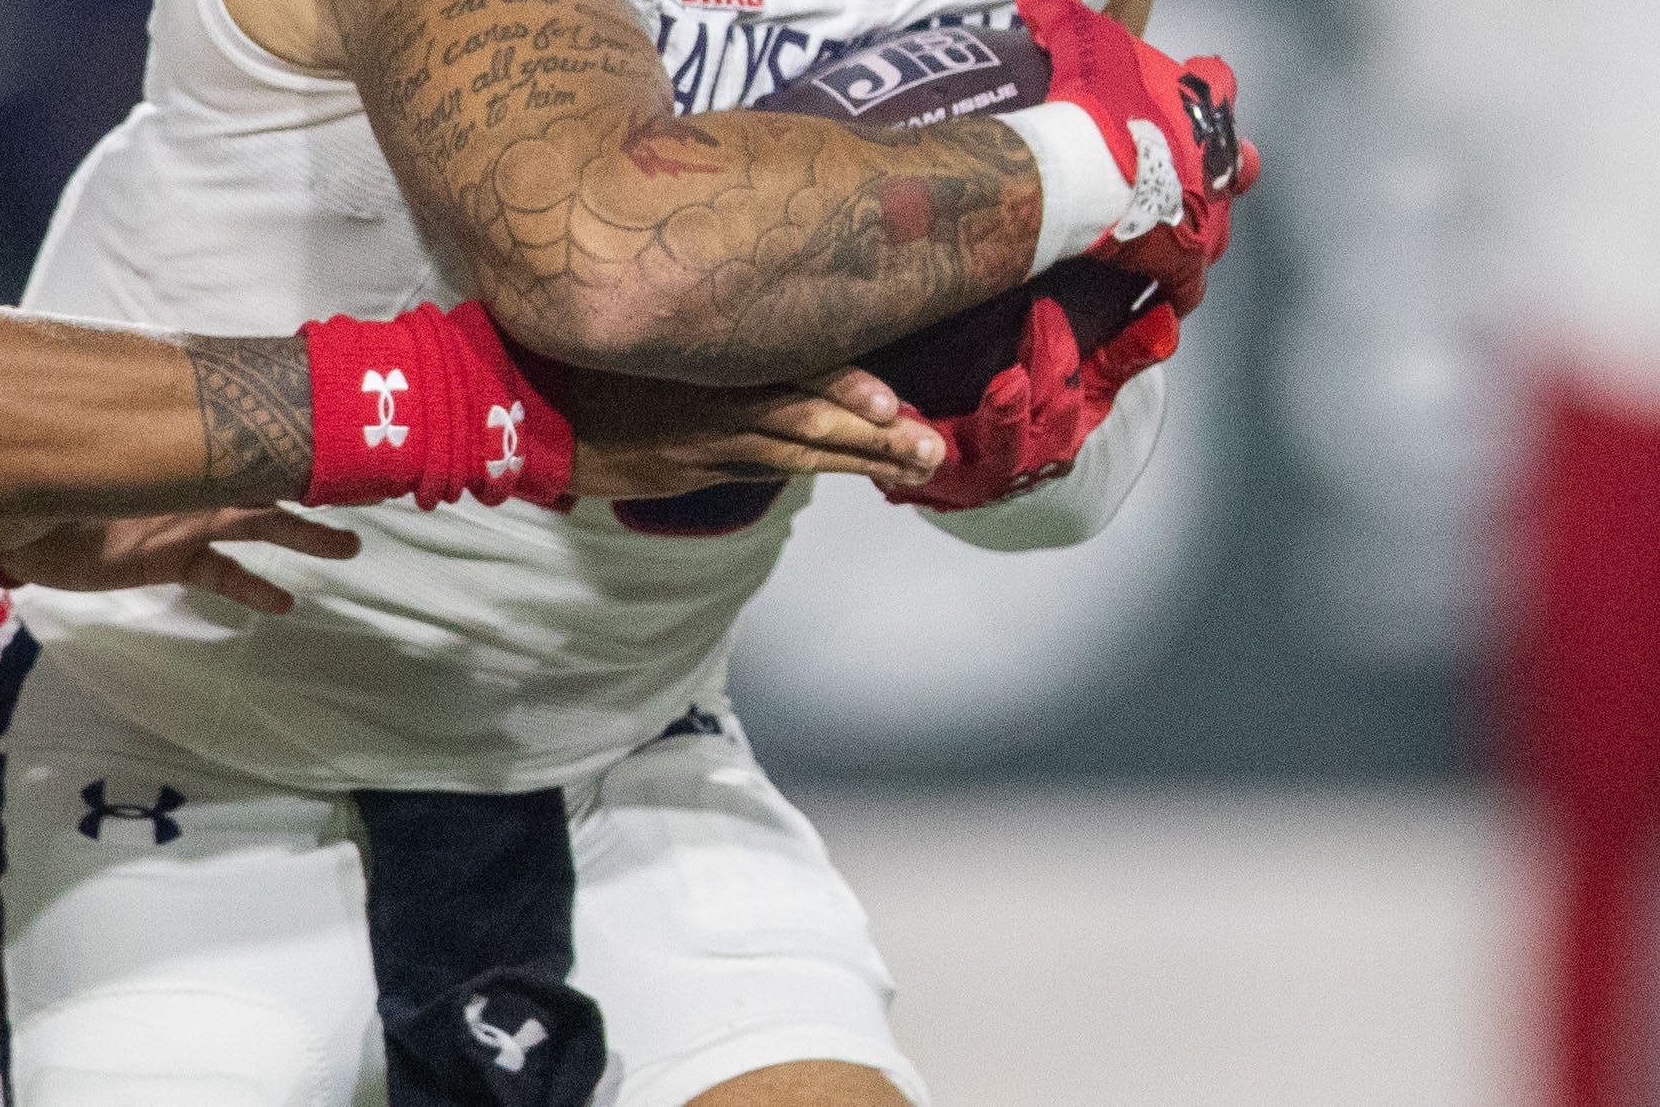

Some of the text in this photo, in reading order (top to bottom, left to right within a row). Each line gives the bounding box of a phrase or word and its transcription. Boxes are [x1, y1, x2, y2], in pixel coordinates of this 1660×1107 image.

[443, 21, 530, 64] cares
[471, 45, 516, 94] all
[510, 55, 597, 92] your
[525, 85, 577, 120] him
